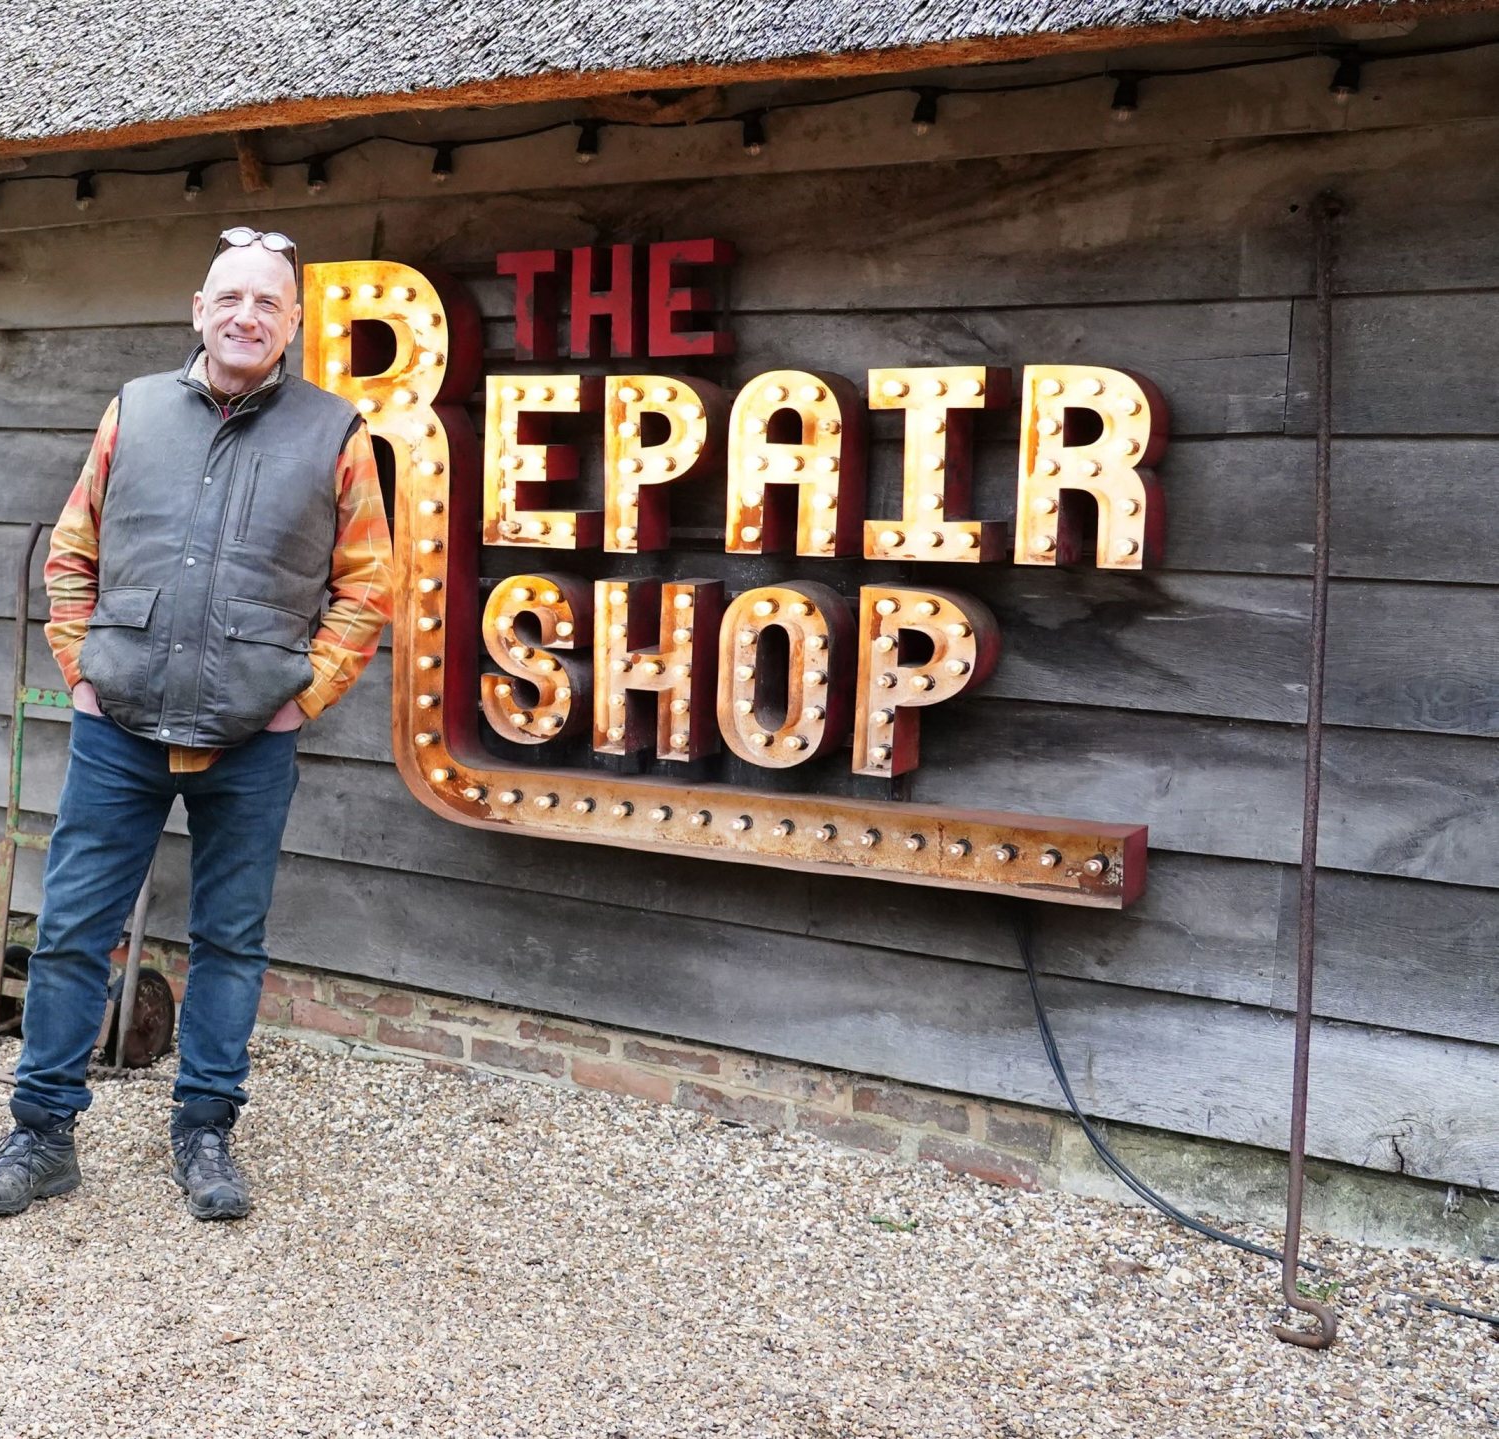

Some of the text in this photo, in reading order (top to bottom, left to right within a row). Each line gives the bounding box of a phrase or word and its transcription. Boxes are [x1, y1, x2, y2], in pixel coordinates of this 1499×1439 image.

[496, 238, 731, 361] THE
[303, 260, 1161, 571] REPAIR
[481, 574, 993, 778] SHOP
